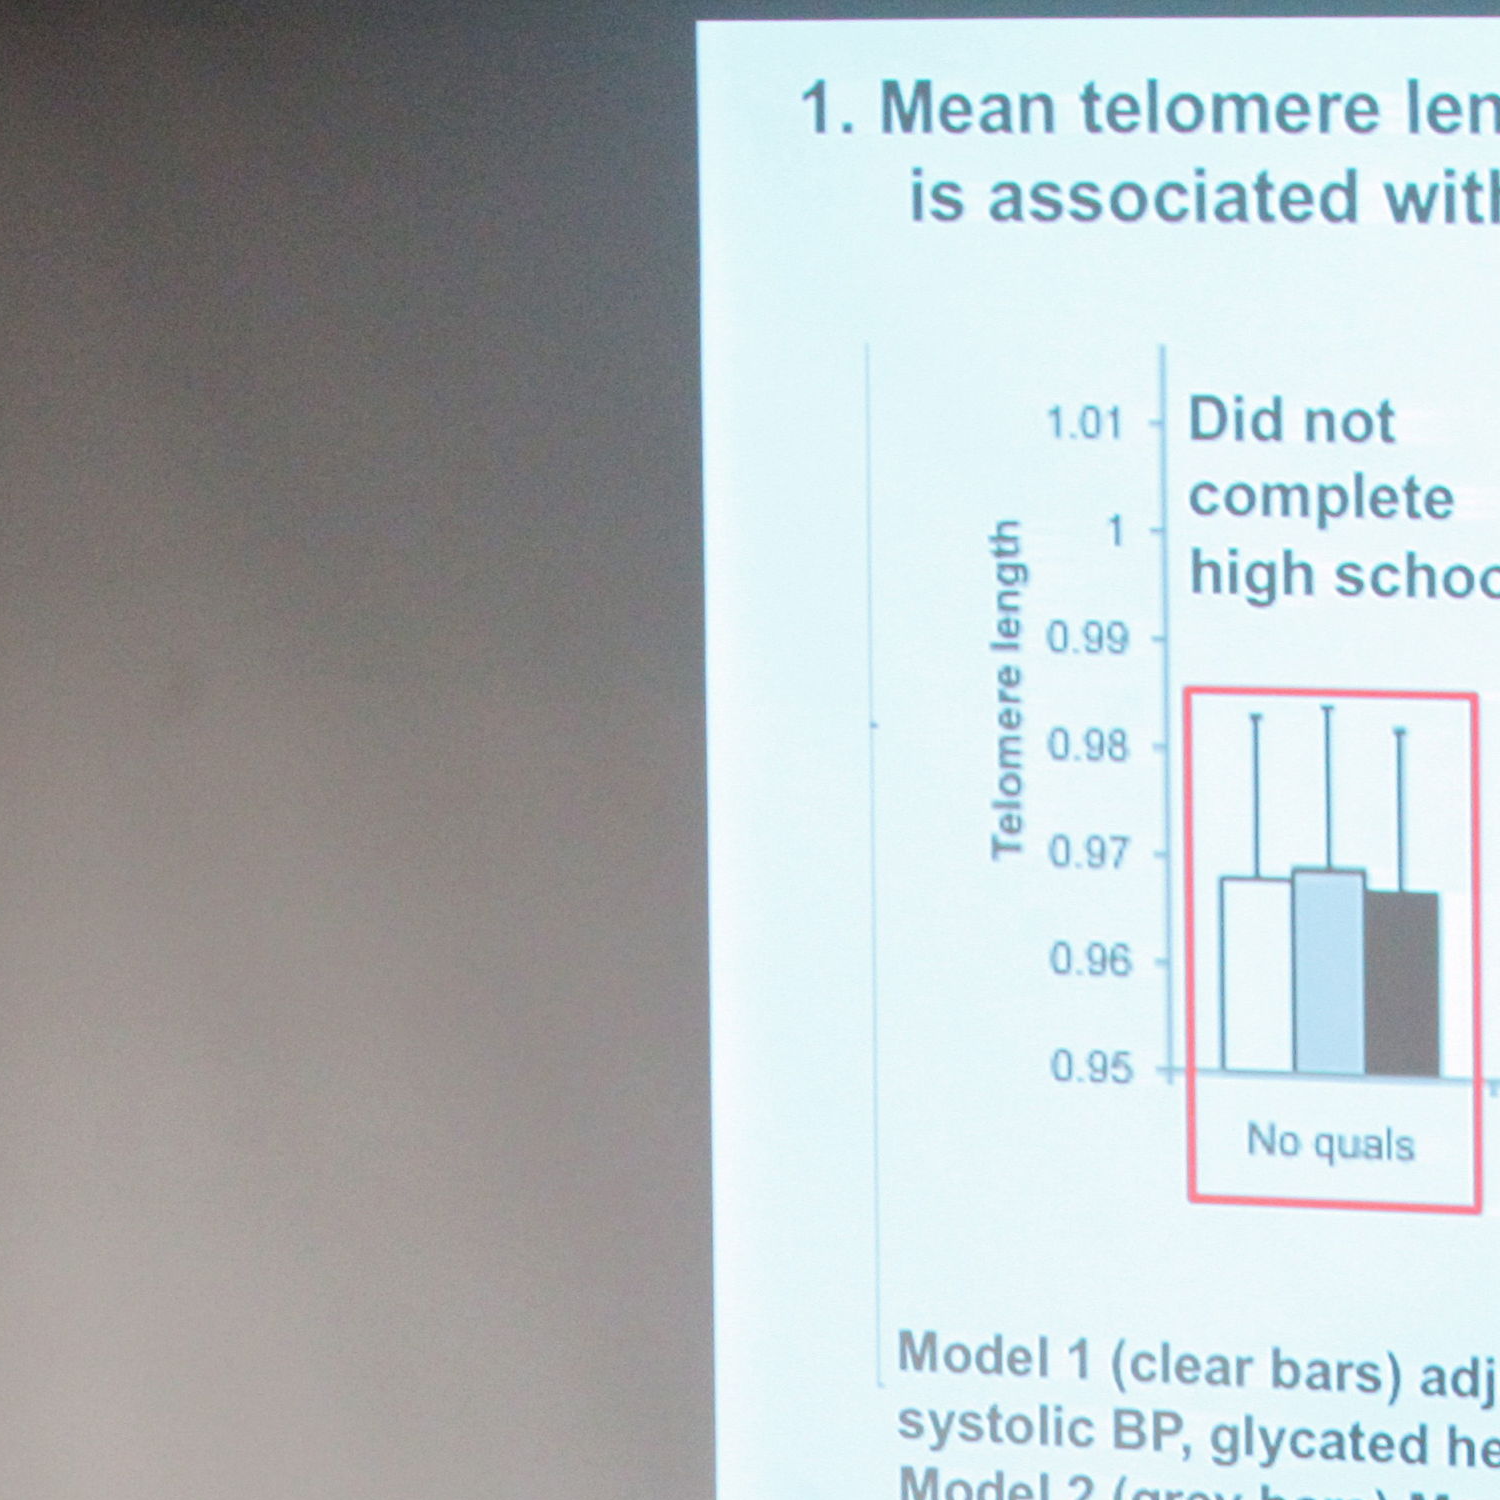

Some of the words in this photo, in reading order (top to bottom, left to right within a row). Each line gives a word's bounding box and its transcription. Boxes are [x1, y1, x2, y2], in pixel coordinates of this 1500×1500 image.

[802, 78, 853, 134] 1.
[881, 78, 1055, 134] Mean
[1079, 77, 1380, 134] telomere
[911, 165, 965, 221] is
[989, 166, 1358, 223] associated
[1048, 403, 1121, 440] 1.01
[1190, 393, 1284, 442] Did
[1305, 399, 1396, 444] not
[1189, 470, 1455, 531] complete
[1108, 513, 1122, 547] 1
[987, 519, 1030, 651] length
[1191, 546, 1315, 608] high
[1046, 618, 1130, 655] 0.99
[990, 663, 1024, 861] Telomere
[1047, 725, 1130, 762] 0.98
[1048, 832, 1131, 870] 0.97
[1049, 939, 1133, 977] 0.96
[1050, 1047, 1135, 1084] 0.95
[1247, 1119, 1303, 1157] No
[1313, 1125, 1416, 1167] quals
[898, 1327, 1049, 1378] Model
[1068, 1336, 1089, 1380] 1
[1111, 1337, 1255, 1394] (clear
[1271, 1345, 1402, 1407] bars)
[897, 1402, 1095, 1453] systolic
[1112, 1406, 1192, 1462] BP,
[1210, 1413, 1429, 1469] glycated
